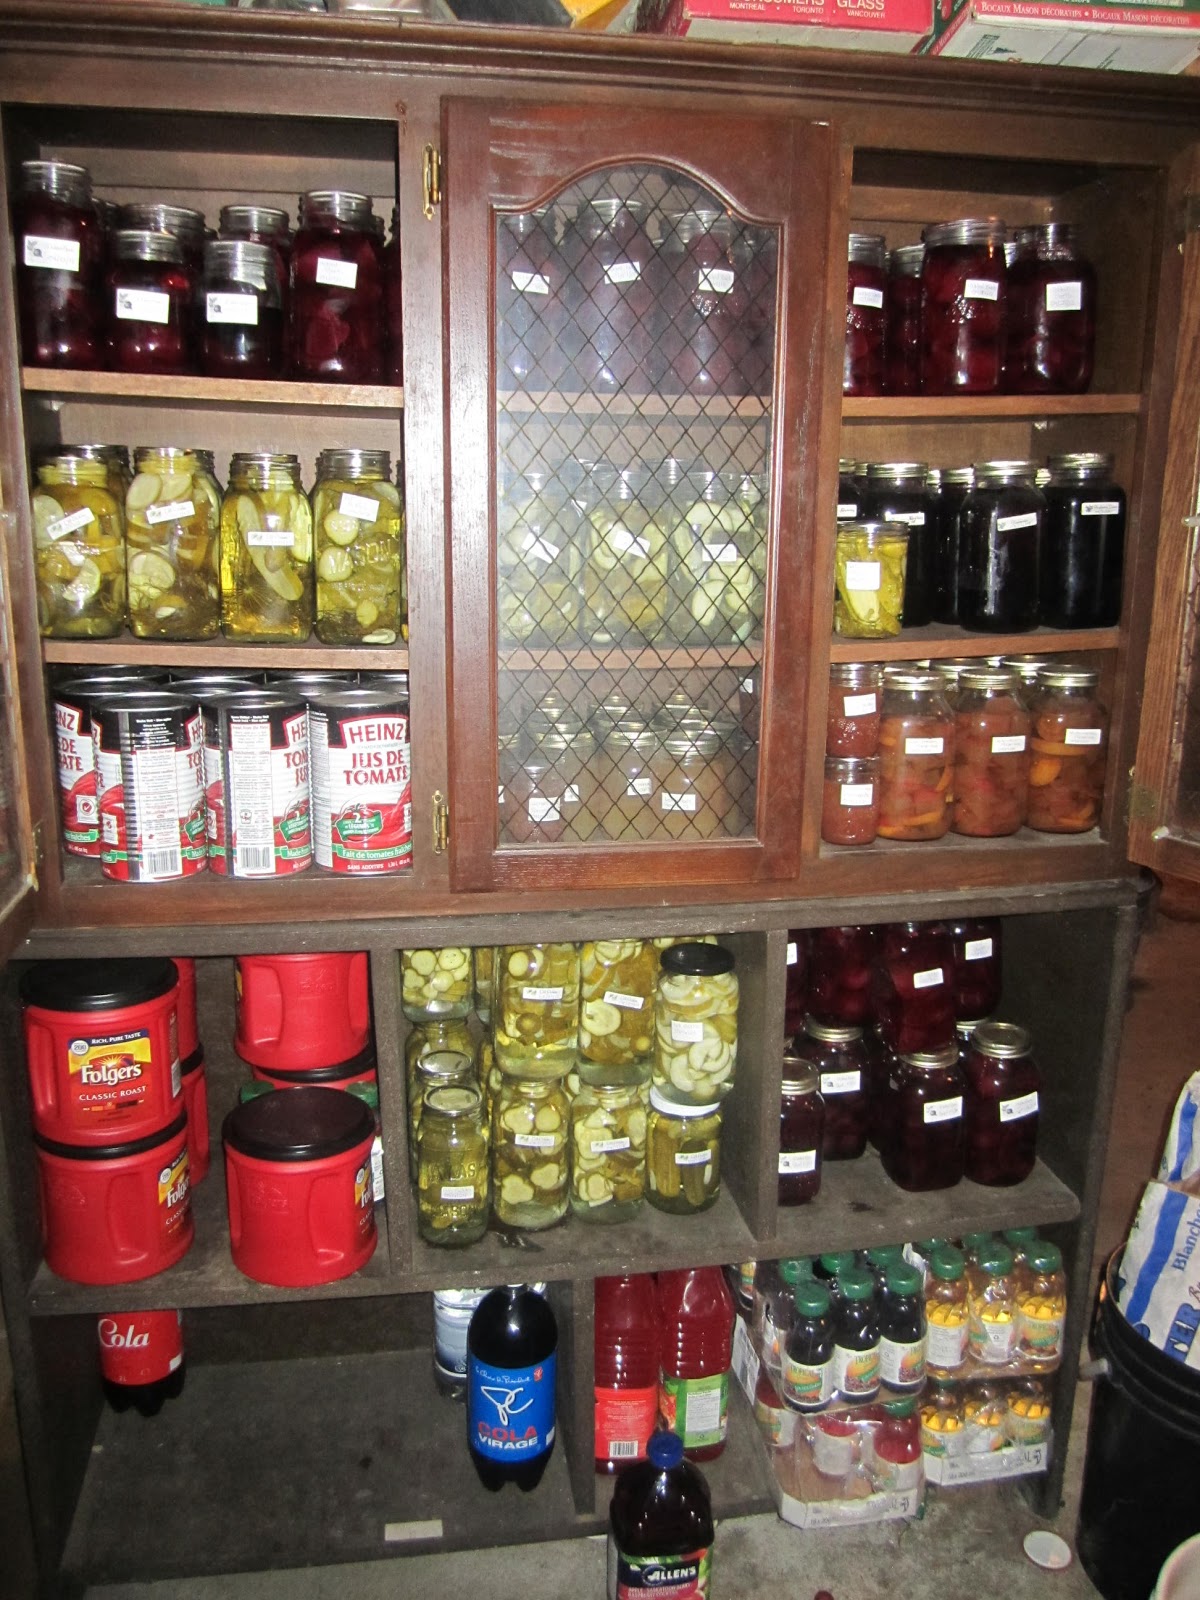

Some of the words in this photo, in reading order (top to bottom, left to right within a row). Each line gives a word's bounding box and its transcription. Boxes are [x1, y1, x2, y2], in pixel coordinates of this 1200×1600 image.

[793, 5, 824, 14] TORONTO
[847, 9, 886, 19] VANCOUVER
[348, 723, 405, 744] HEINZ
[352, 751, 383, 769] JUS
[386, 749, 405, 767] DE
[343, 764, 408, 786] TOMATE
[352, 812, 362, 824] 2
[343, 849, 355, 858] Fait
[356, 850, 365, 859] de
[366, 849, 394, 859] tomates
[109, 1035, 124, 1043] PURE
[125, 1031, 141, 1040] TASTE
[81, 1063, 142, 1086] Folgers
[79, 1091, 118, 1101] CLASSIC
[120, 1085, 147, 1098] ROAST
[98, 1319, 150, 1348] Cola
[478, 1421, 538, 1442] COLA
[478, 1432, 539, 1449] VIRAGE
[647, 1566, 697, 1581] ALLEN'S
